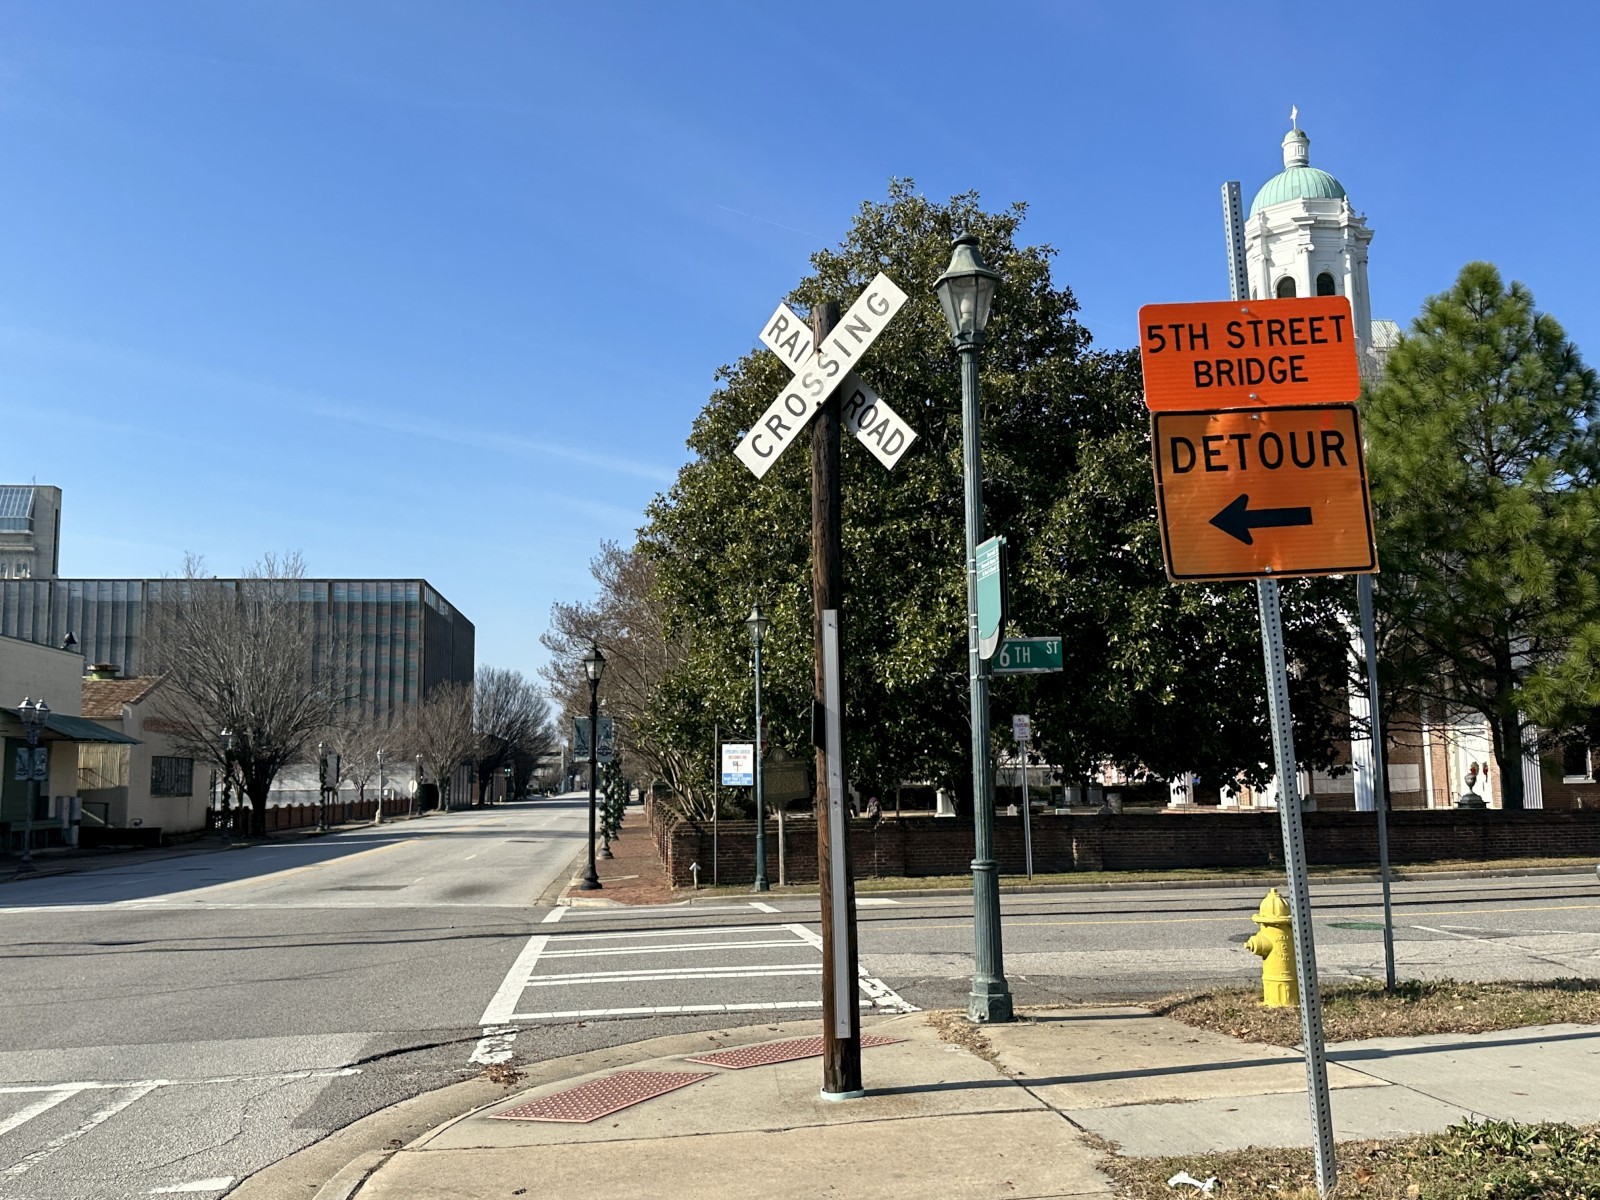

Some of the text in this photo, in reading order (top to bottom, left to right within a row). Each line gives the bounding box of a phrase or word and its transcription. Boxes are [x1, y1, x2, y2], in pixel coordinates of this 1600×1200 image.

[1147, 315, 1346, 353] 5TH STREET
[751, 292, 890, 459] CROSSING
[767, 315, 904, 456] RAI ROAD
[1194, 355, 1308, 388] BRIDGE
[1170, 430, 1348, 474] DETOUR
[1046, 641, 1059, 655] ST
